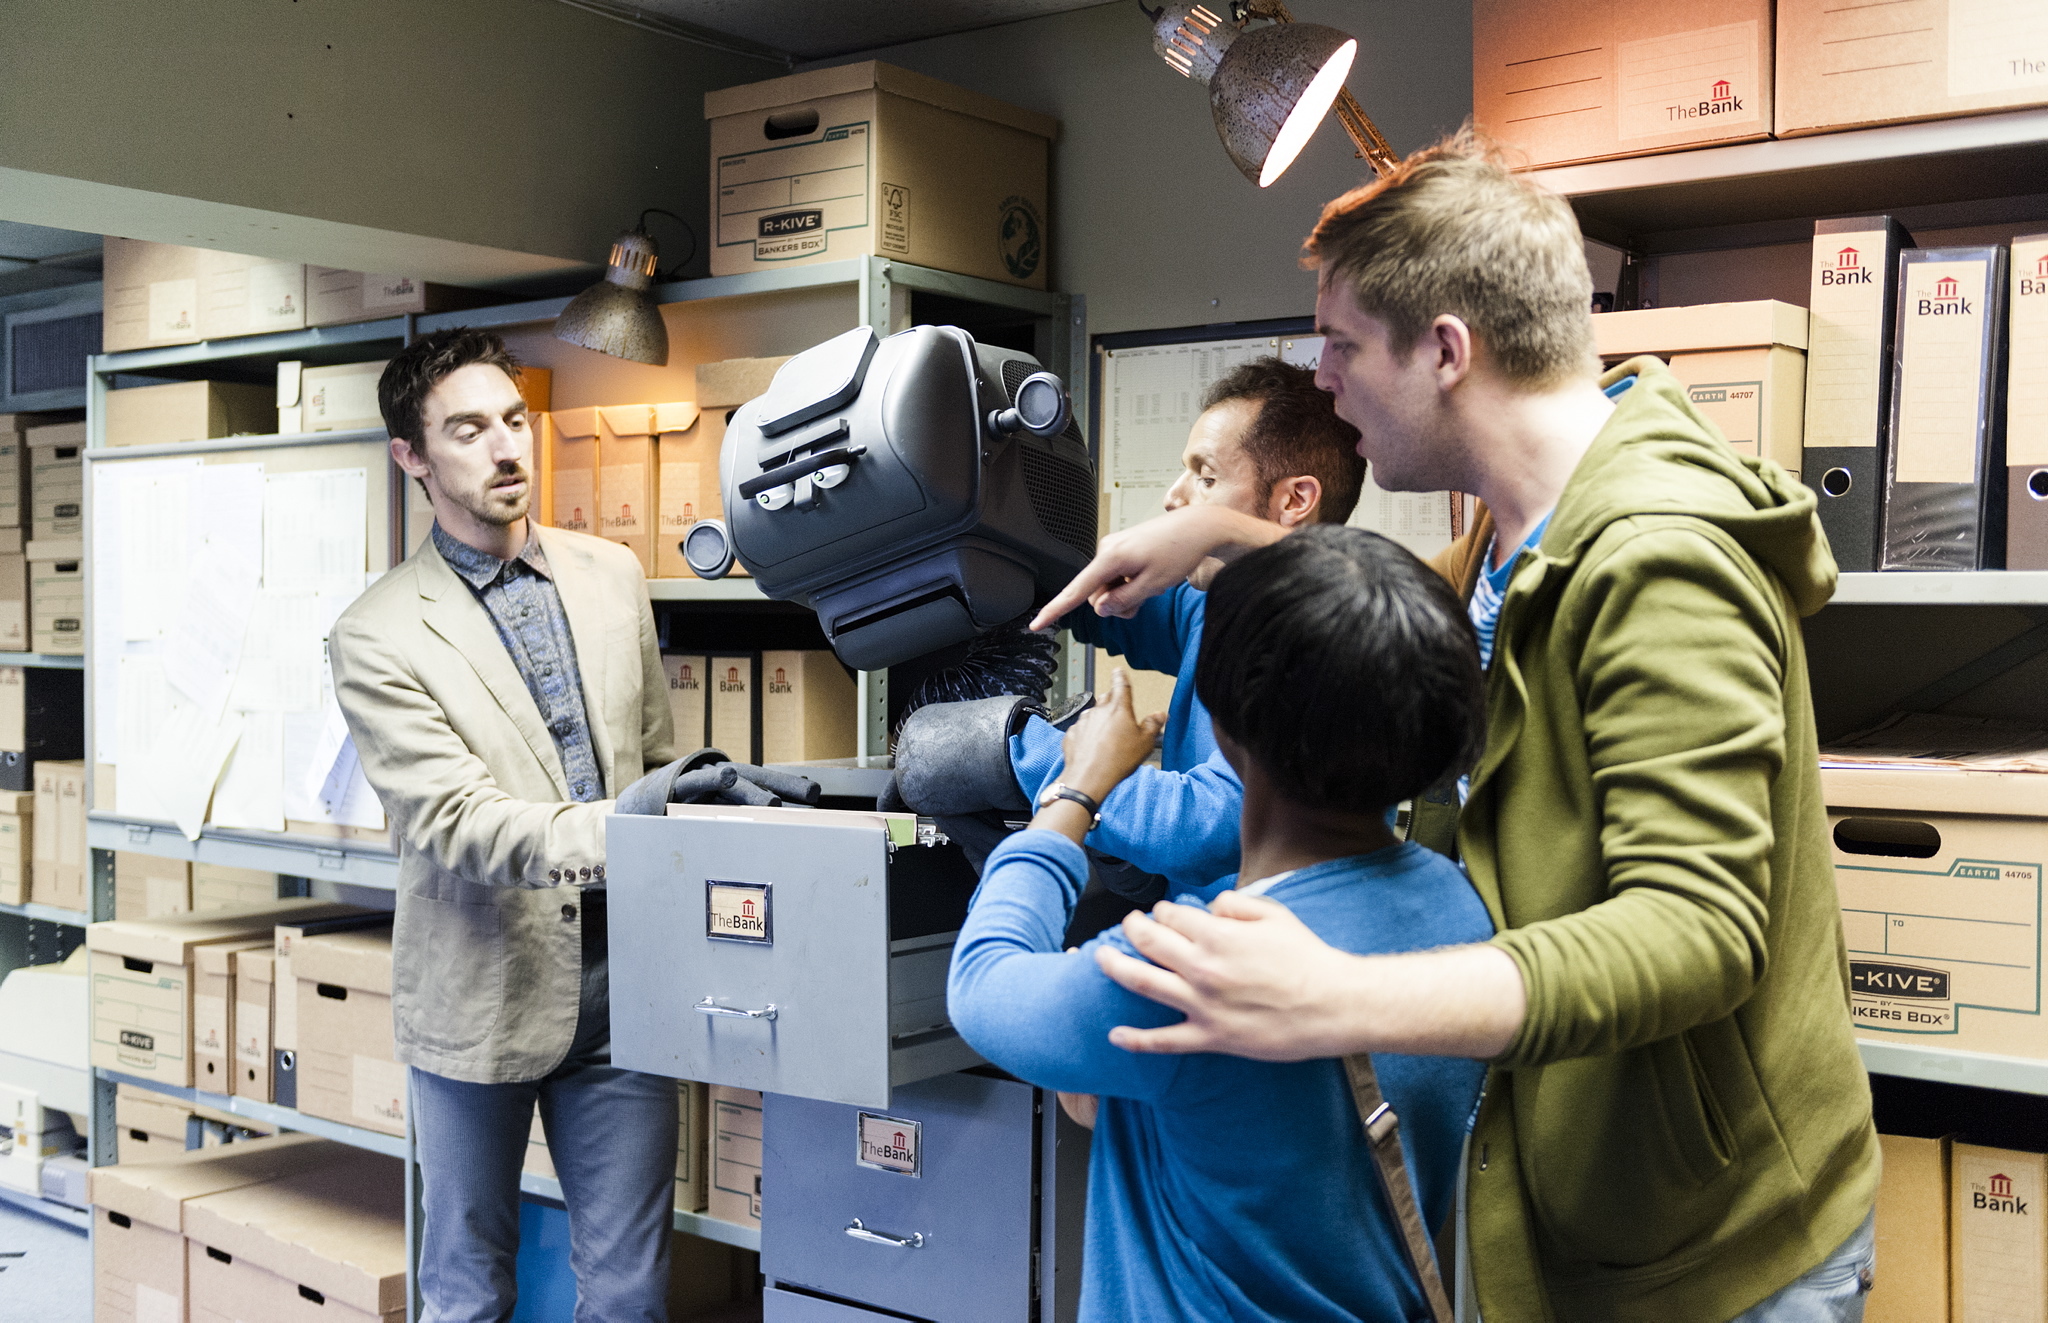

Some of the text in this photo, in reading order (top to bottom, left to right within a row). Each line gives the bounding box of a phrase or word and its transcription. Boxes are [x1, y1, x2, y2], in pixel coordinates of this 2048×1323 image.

[1665, 95, 1744, 121] TheBank
[763, 214, 816, 233] R-KIVE
[758, 240, 820, 256] BANKERS BOX
[1820, 260, 1834, 269] The
[1821, 266, 1872, 286] Bank
[2020, 279, 2046, 296] Ba
[1918, 297, 1973, 316] Bank
[1692, 391, 1753, 401] EARTH 44707
[600, 516, 637, 528] TheBank
[670, 677, 699, 690] Bank
[720, 680, 745, 692] Bank
[769, 681, 792, 694] Bank
[1960, 868, 2032, 880] EARTH 44705
[711, 912, 763, 931] TheBank
[1892, 919, 1904, 927] TO
[1854, 971, 1934, 992] -KIVE
[1907, 1011, 1943, 1025] BOX
[862, 1140, 913, 1163] TheBank
[1970, 1182, 1986, 1191] The
[1973, 1192, 2028, 1215] Bank
